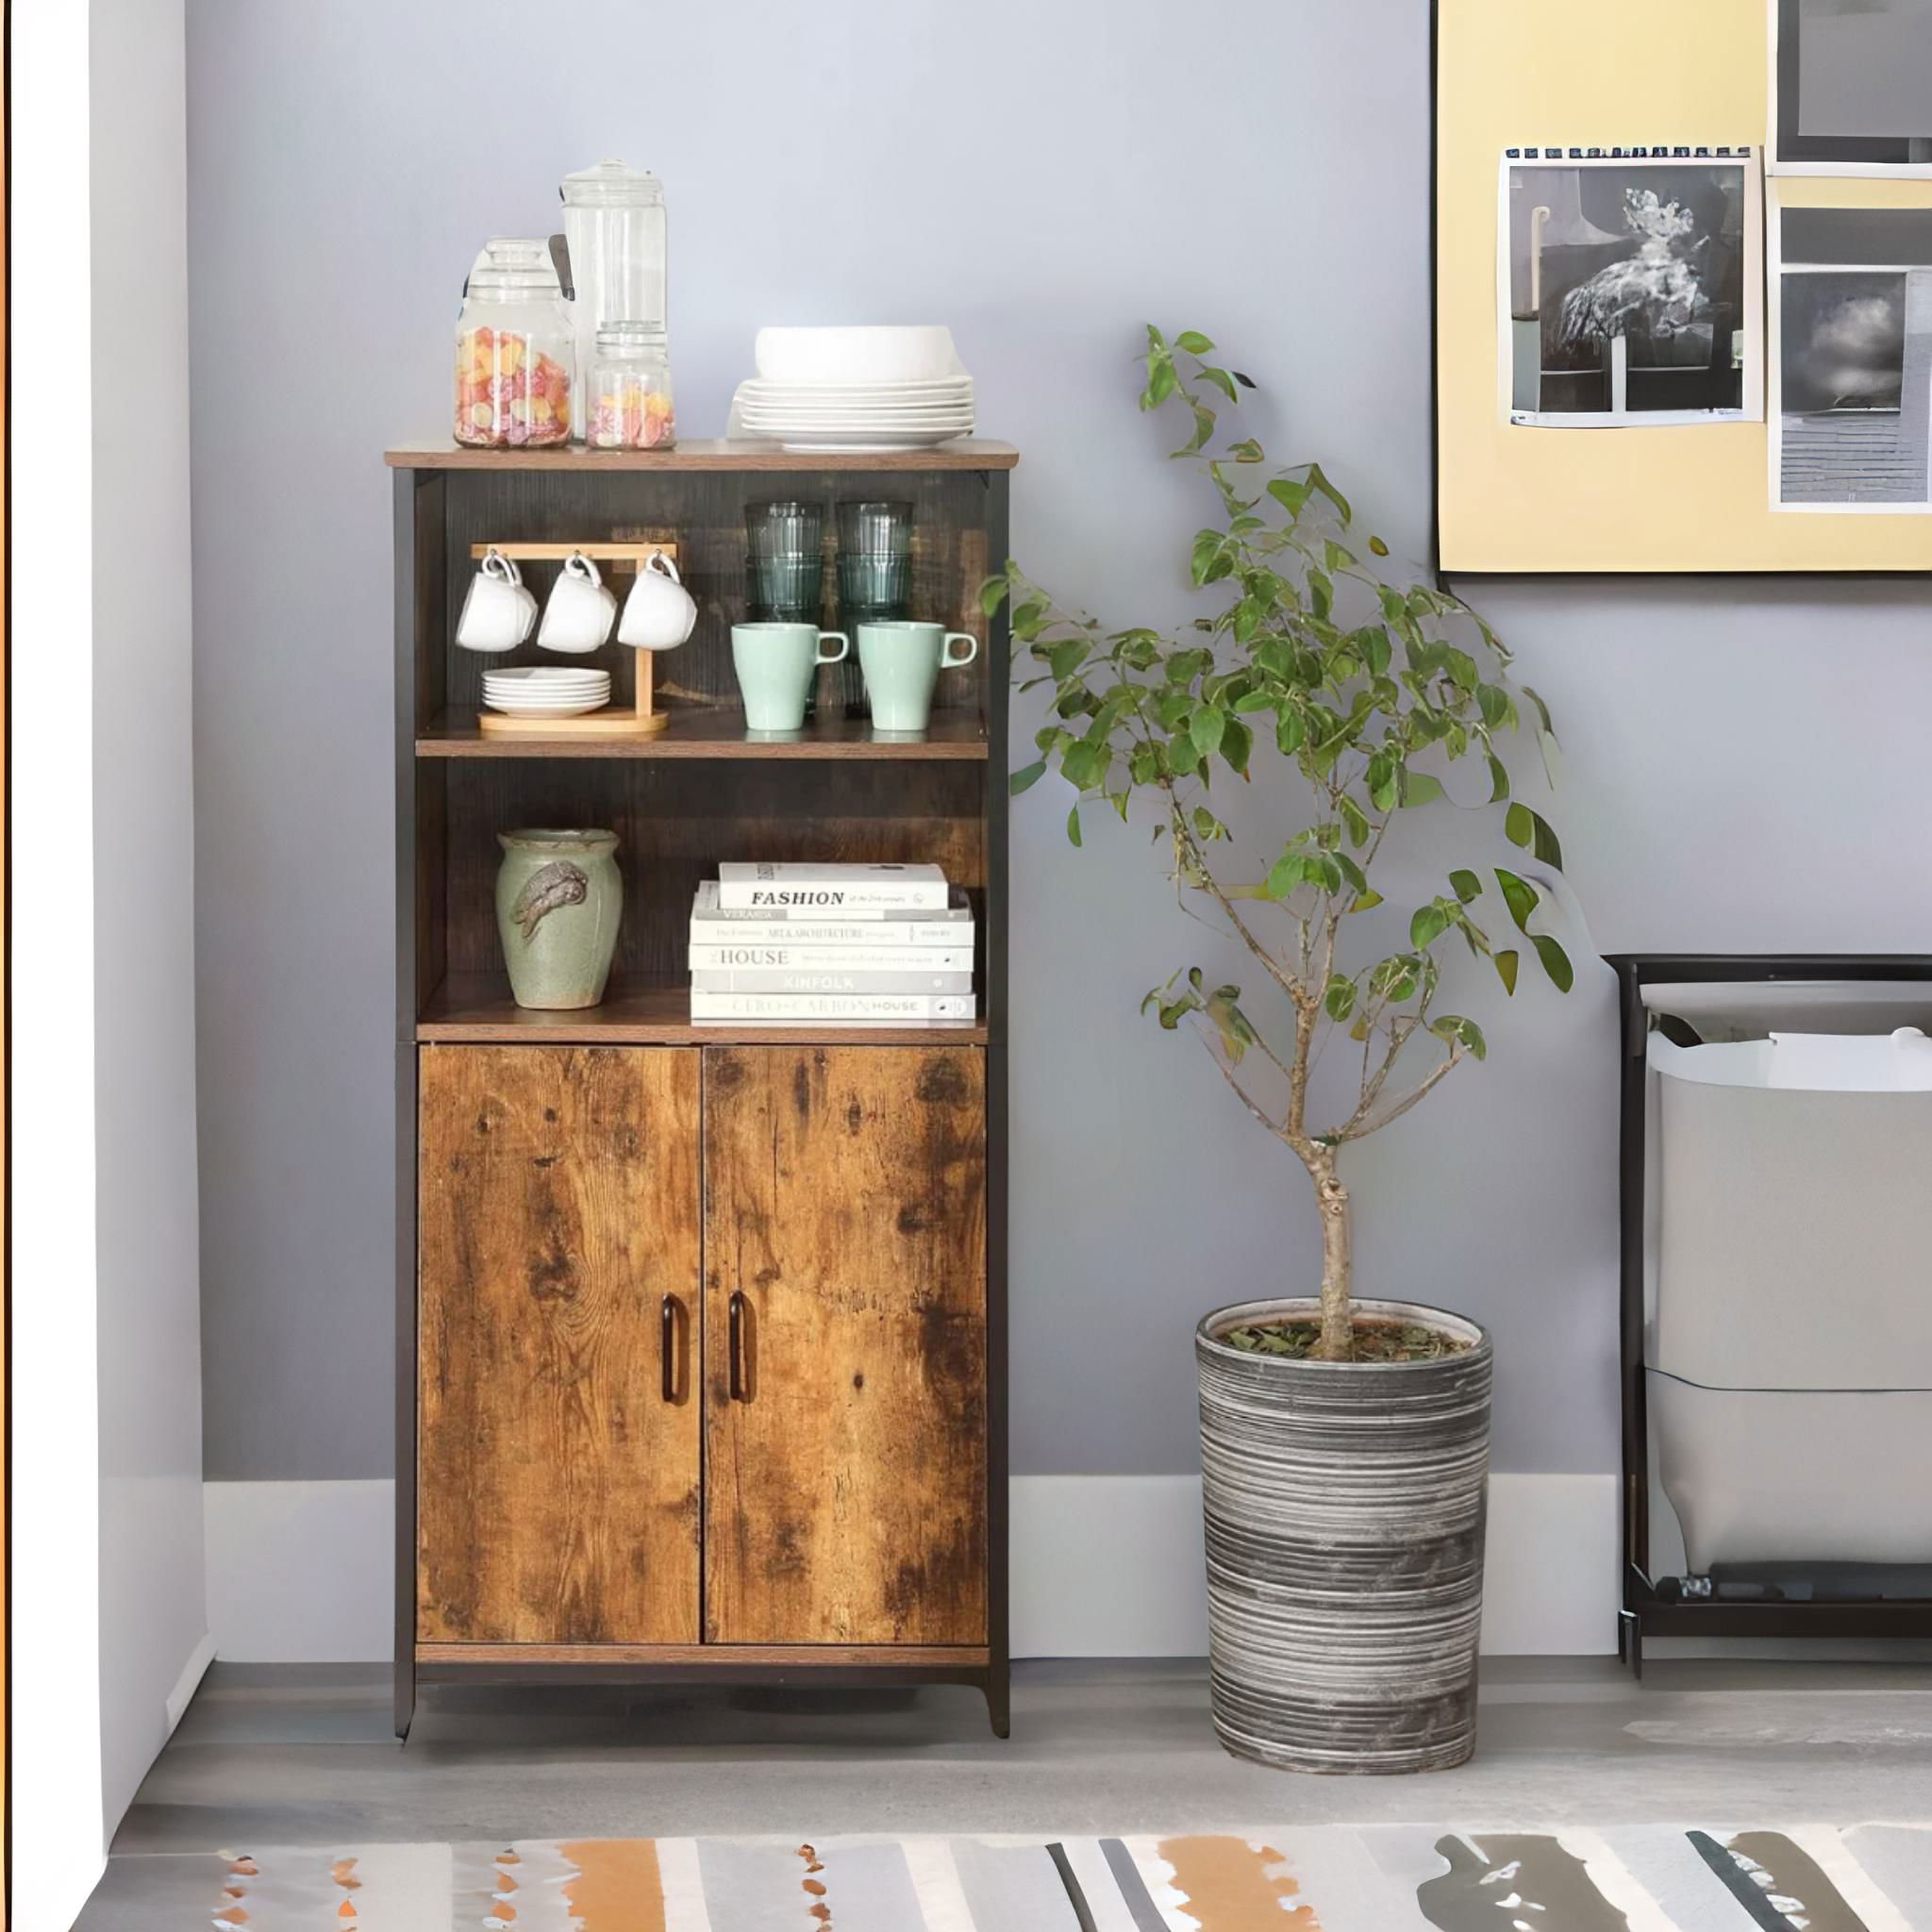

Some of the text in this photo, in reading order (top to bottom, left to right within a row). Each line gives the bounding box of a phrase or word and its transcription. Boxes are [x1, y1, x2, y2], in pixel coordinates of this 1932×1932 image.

[751, 891, 844, 906] FASHION
[721, 949, 791, 965] HOUSE
[872, 1001, 920, 1011] HOUSE
